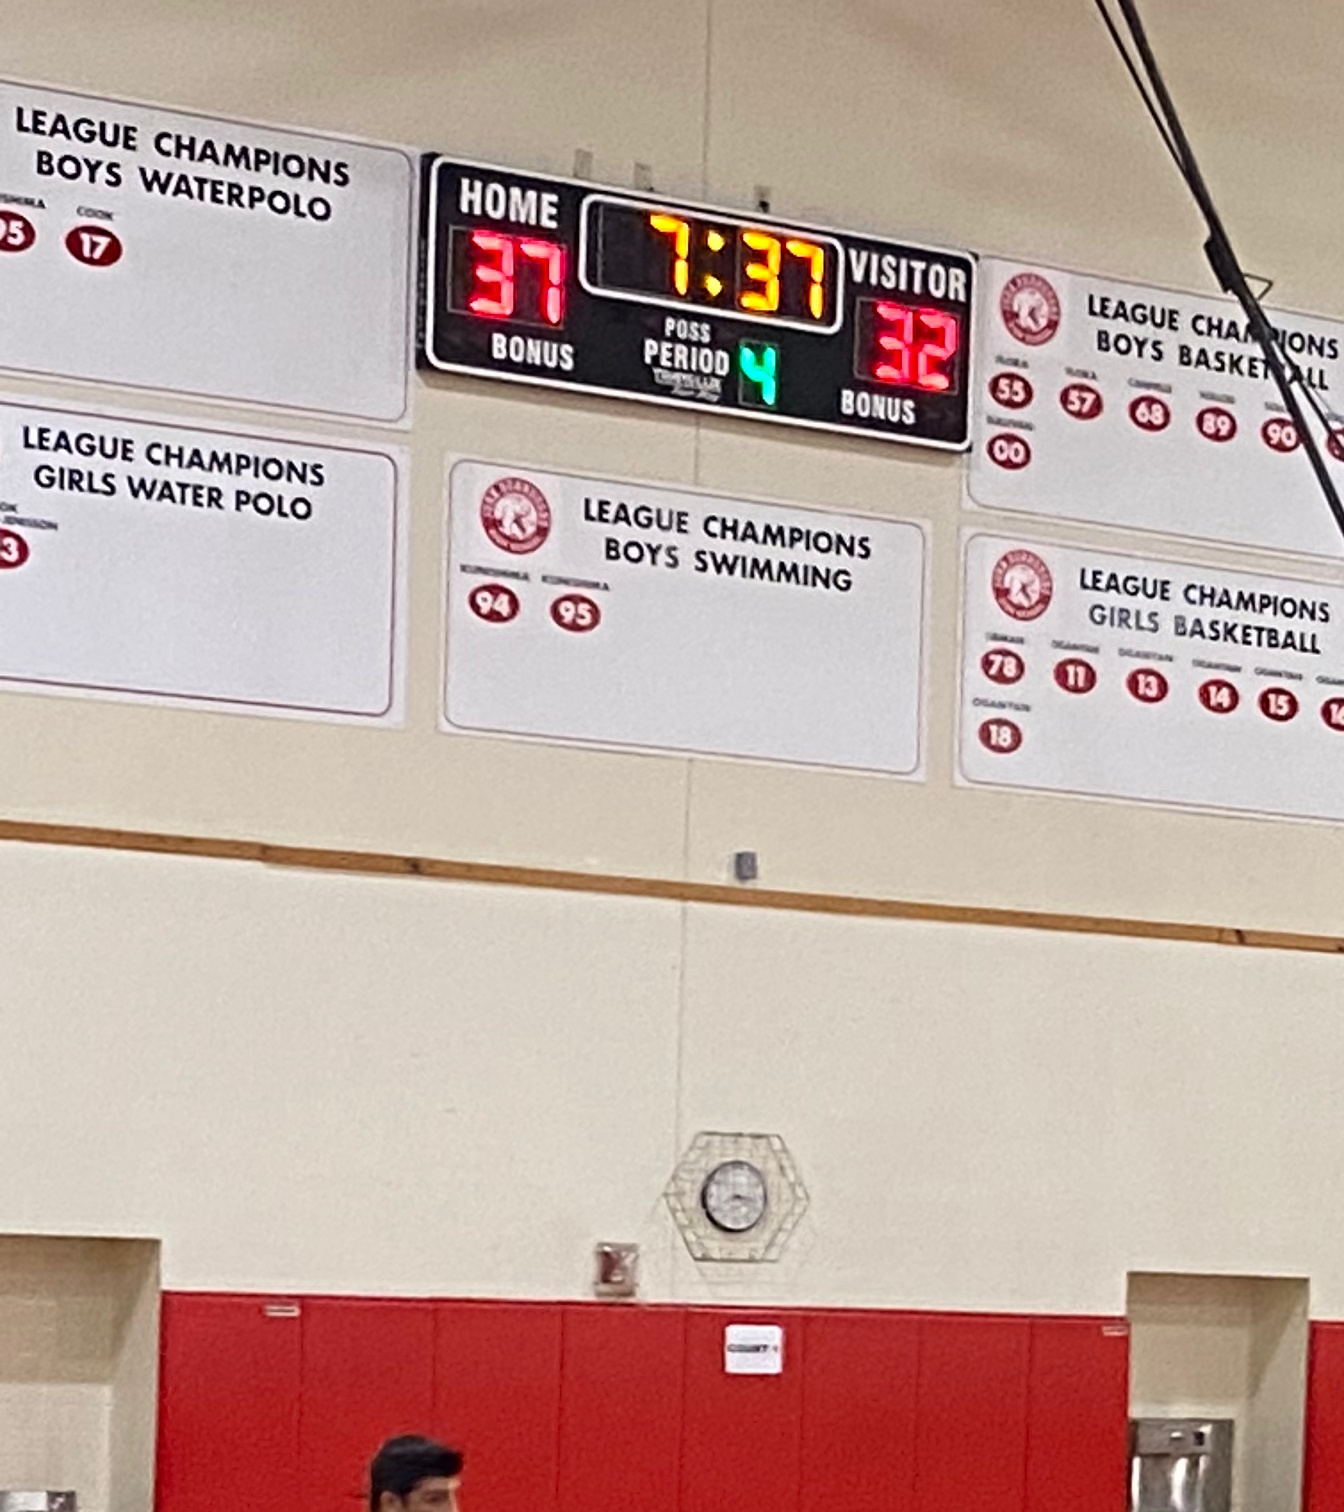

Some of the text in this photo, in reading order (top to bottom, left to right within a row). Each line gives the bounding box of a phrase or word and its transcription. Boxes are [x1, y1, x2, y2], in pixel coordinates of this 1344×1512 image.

[16, 107, 350, 187] LEAGUE CHAMPIONS
[37, 151, 332, 221] BOYS WATERPOLO
[460, 178, 559, 229] HOME
[78, 230, 112, 260] 17
[649, 212, 825, 320] 7:37
[469, 230, 562, 327] 37
[849, 248, 968, 302] VISITOR
[492, 333, 575, 372] BONUS
[664, 316, 711, 343] POSS
[874, 301, 959, 391] 32
[1088, 294, 1339, 361] LEAGUE CHAIONS
[644, 338, 730, 377] PERIOD
[740, 346, 776, 405] 4
[1097, 330, 1164, 362] BOYS
[1179, 345, 1329, 392] BASKETALL
[841, 388, 916, 426] BONUS
[997, 377, 1026, 403] 55
[1067, 389, 1096, 414] 57
[1135, 401, 1165, 426] 68
[1202, 412, 1232, 436] 89
[1267, 423, 1297, 447] 90
[22, 425, 324, 486] LEAGUE CHAMPIONS
[992, 439, 1026, 464] 00
[33, 465, 312, 520] GIRLS WATER POLO
[584, 497, 871, 559] LEAGUE CHAMPIONS
[605, 538, 853, 593] BOYS SWIMMING
[475, 590, 593, 626] 94 95
[1080, 567, 1331, 623] LEAGUE CHAMPIONS
[1089, 604, 1321, 655] GIRLS BASKETBALL
[988, 654, 1017, 678] 78
[1065, 664, 1087, 689] 11
[1137, 674, 1159, 698] 13
[1208, 686, 1231, 708] 14
[1267, 694, 1290, 716] 15
[988, 724, 1012, 748] 18
